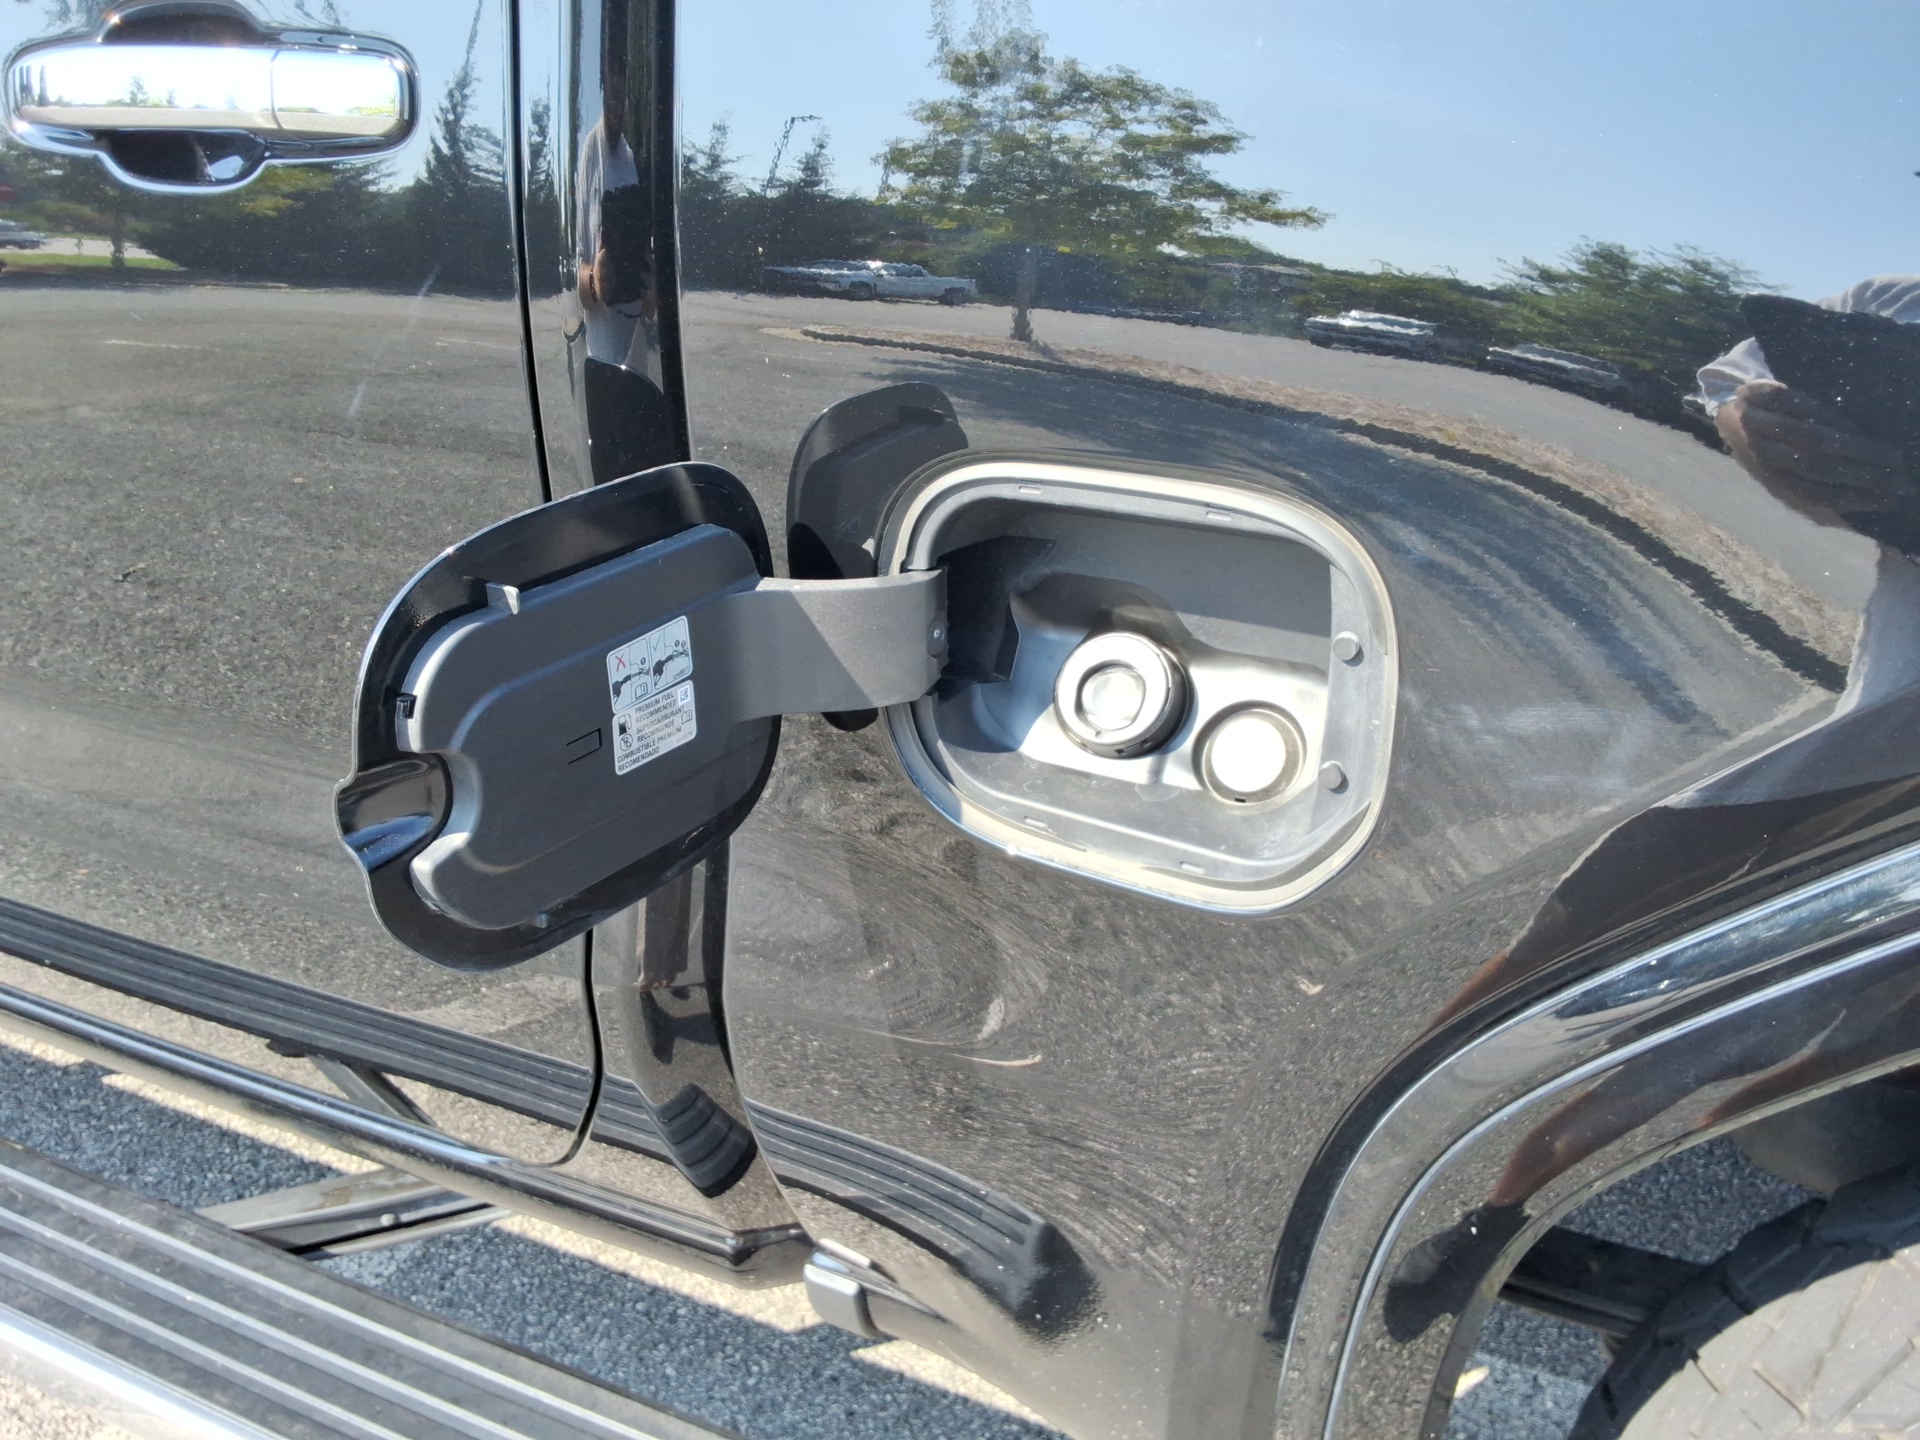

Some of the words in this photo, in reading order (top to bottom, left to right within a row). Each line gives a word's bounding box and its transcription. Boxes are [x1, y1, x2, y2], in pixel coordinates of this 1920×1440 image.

[635, 698, 660, 714] PREMIUM
[661, 691, 674, 702] FUEL
[636, 700, 677, 723] RECOMMENDED
[636, 705, 685, 734] SUPERCARBURANT
[617, 739, 656, 763] COMBUSTIBLE
[657, 726, 681, 744] PREMIUM
[618, 747, 660, 772] RECOMENDADO
